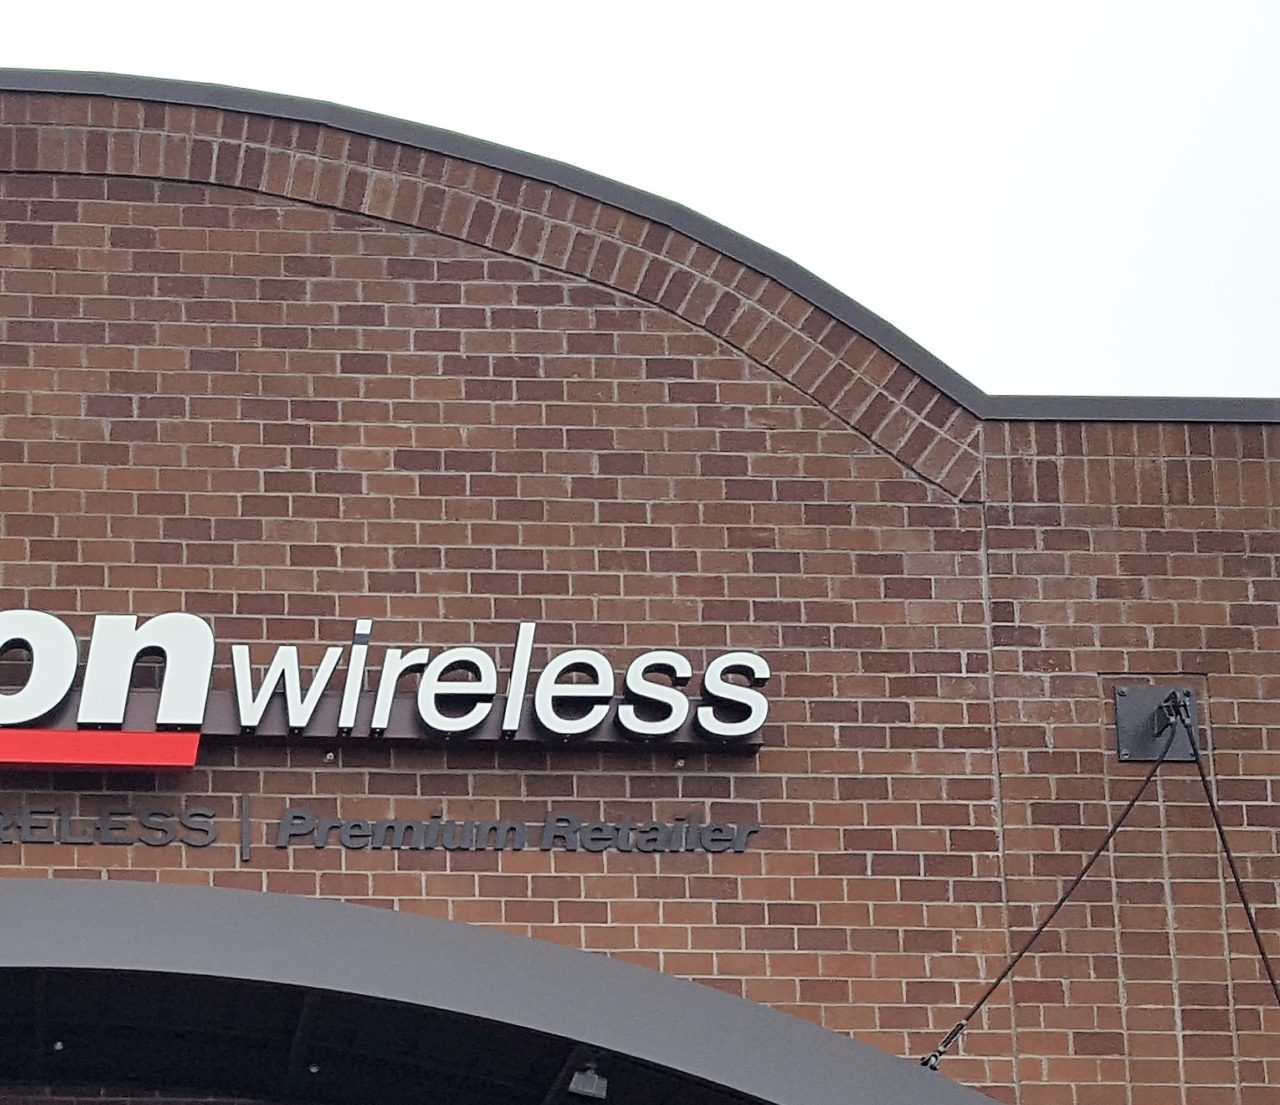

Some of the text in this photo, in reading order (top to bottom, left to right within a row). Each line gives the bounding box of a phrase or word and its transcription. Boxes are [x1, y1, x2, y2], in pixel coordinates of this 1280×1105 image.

[233, 619, 772, 740] wireless
[275, 806, 522, 852] Premium
[539, 811, 759, 854] Retailer
